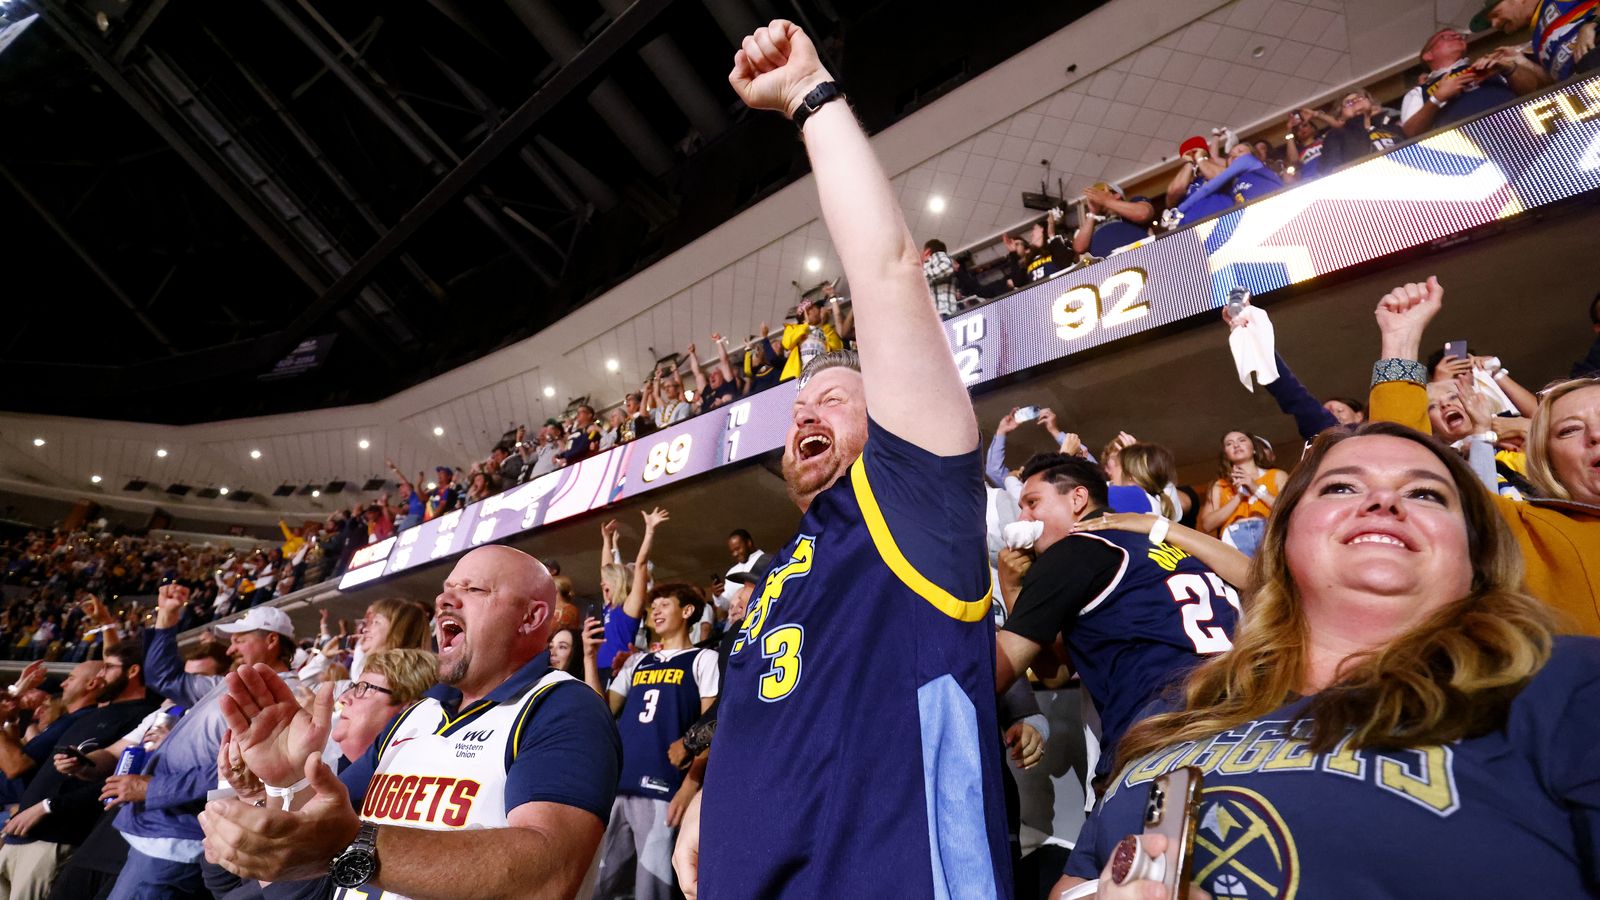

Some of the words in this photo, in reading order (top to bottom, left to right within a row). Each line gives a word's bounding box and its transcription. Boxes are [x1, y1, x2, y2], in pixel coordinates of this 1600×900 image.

[1051, 267, 1150, 341] 92
[952, 313, 987, 347] TO
[953, 345, 983, 384] 2
[728, 401, 751, 430] TO
[642, 433, 693, 482] 89
[728, 430, 740, 462] 1
[632, 668, 684, 687] DENVER
[758, 623, 805, 703] 3
[638, 689, 660, 724] 3
[455, 743, 484, 751] Western
[462, 729, 495, 742] WU
[455, 750, 476, 759] Union
